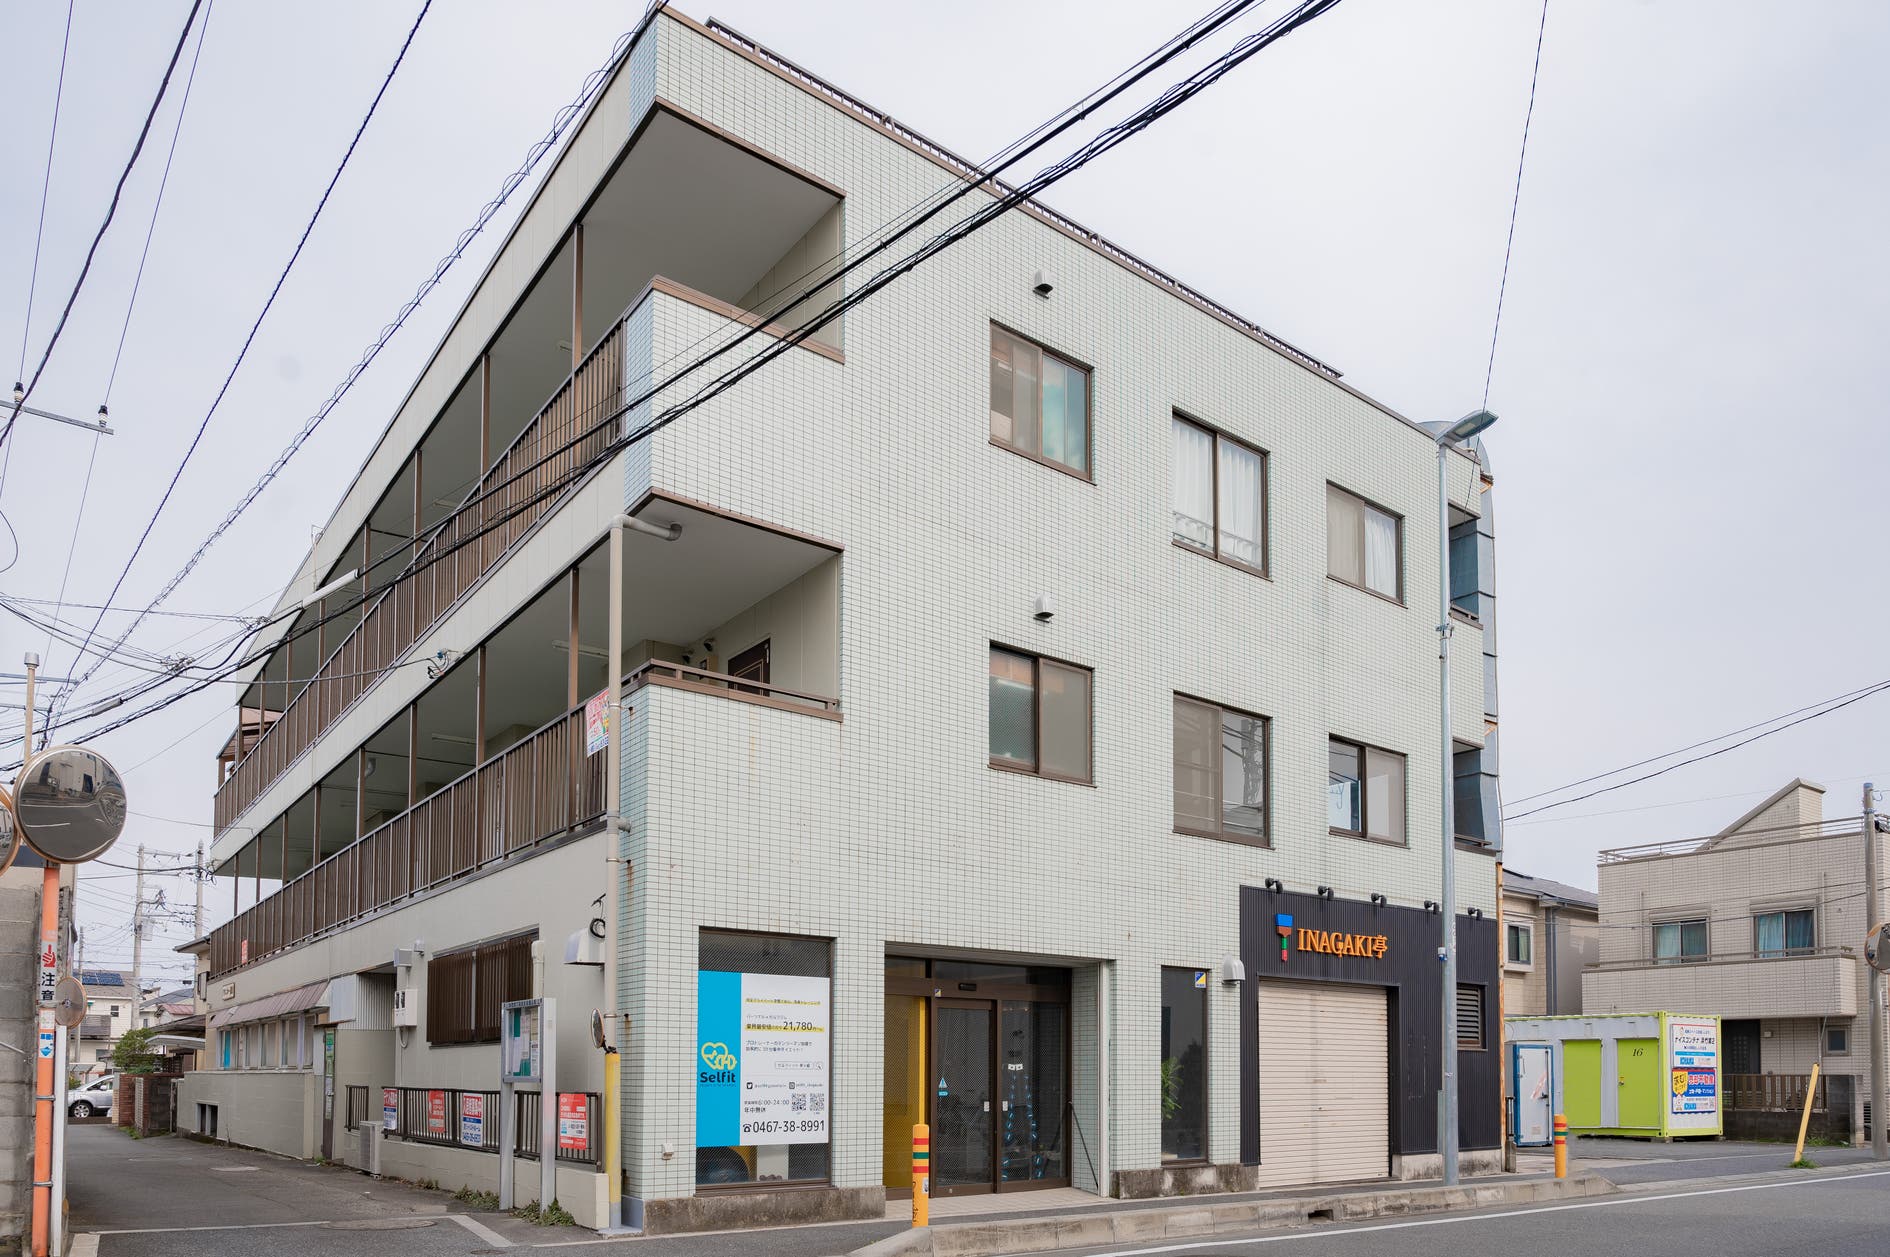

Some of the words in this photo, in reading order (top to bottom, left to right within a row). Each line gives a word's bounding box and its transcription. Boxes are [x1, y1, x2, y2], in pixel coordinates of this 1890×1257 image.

[783, 1021, 813, 1031] 21,780
[1632, 1048, 1643, 1057] 16
[700, 1071, 736, 1083] Selfit
[753, 1120, 825, 1133] 0467-38-8991
